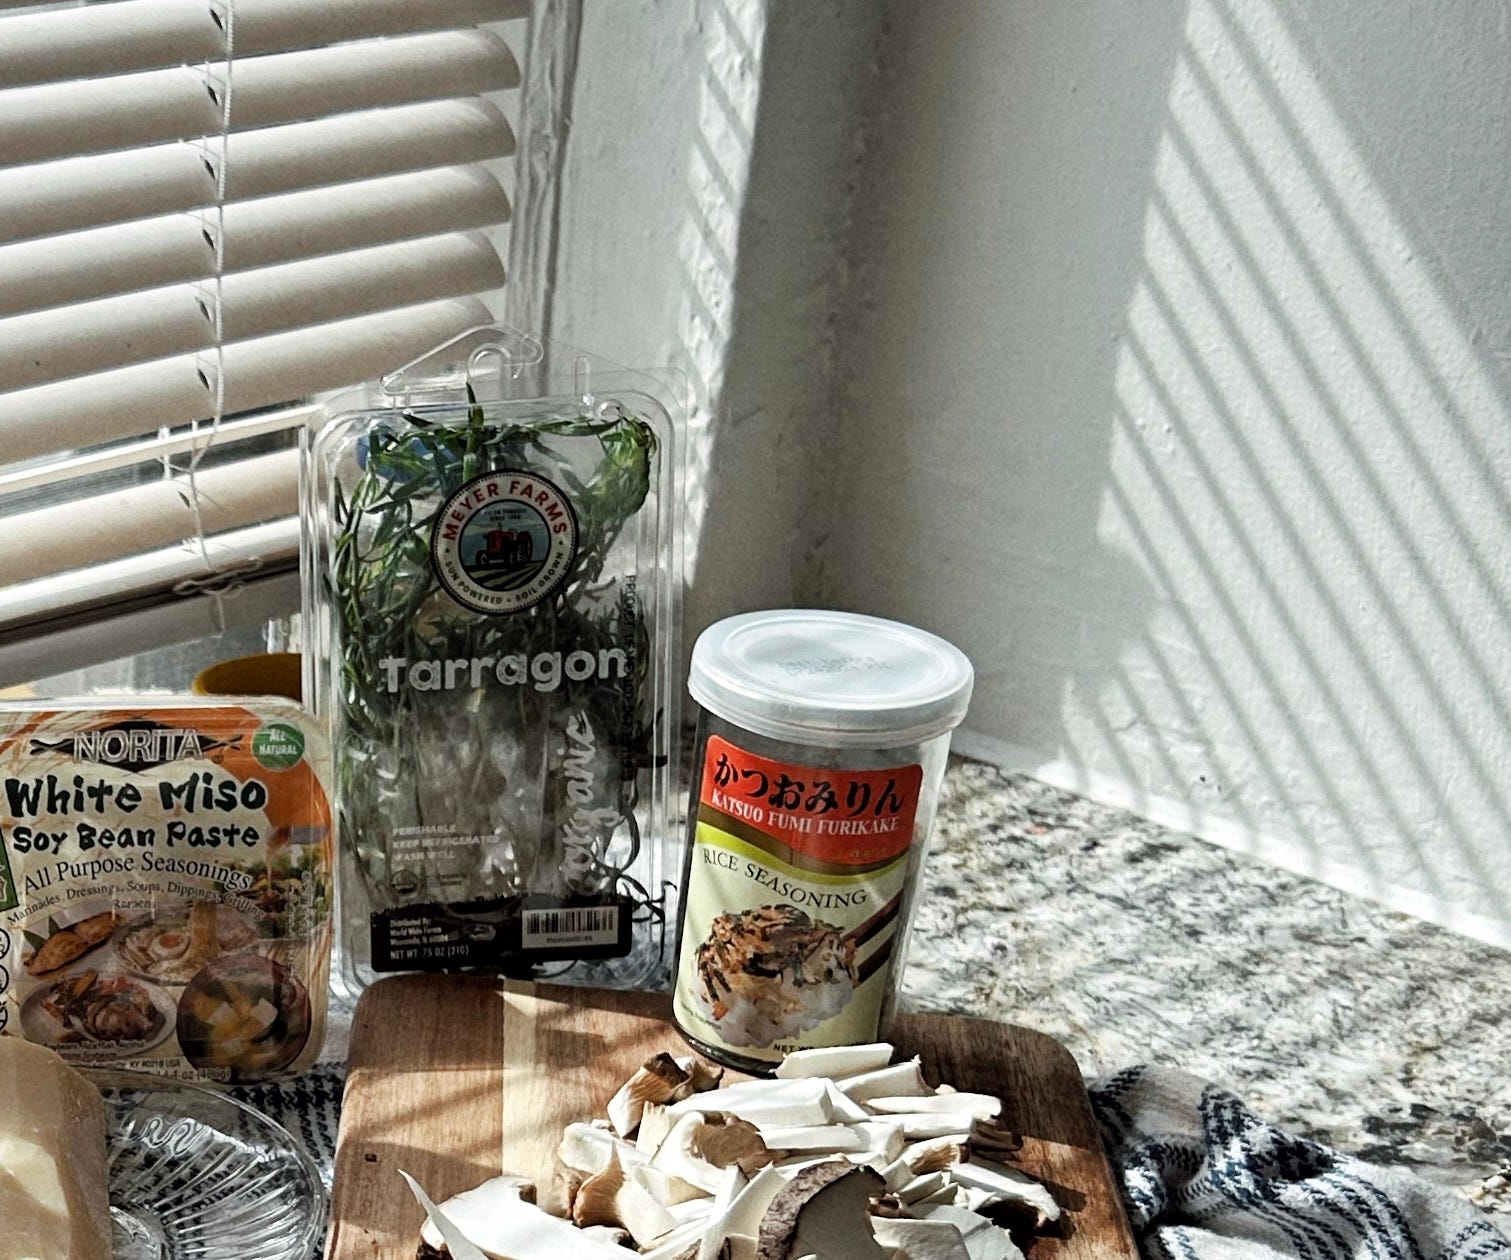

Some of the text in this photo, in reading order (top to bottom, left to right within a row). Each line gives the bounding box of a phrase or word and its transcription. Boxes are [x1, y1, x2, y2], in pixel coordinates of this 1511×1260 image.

[442, 480, 567, 541] MEYER FARMS
[445, 561, 460, 581] SUN
[458, 581, 503, 605] POWERED
[538, 552, 564, 587] GROWN
[73, 729, 204, 763] NORITA
[259, 744, 298, 755] NATURAL
[269, 729, 286, 741] ALL
[5, 772, 267, 818] White Miso
[714, 752, 905, 818] かつおみりん
[711, 788, 900, 836] KATSUO FUMI FURIKAKE
[13, 821, 260, 855] Soy Bean Paste
[25, 851, 252, 896] All Purpose Seasonings
[703, 848, 867, 909] RICE SEASONING
[390, 949, 405, 960] NET
